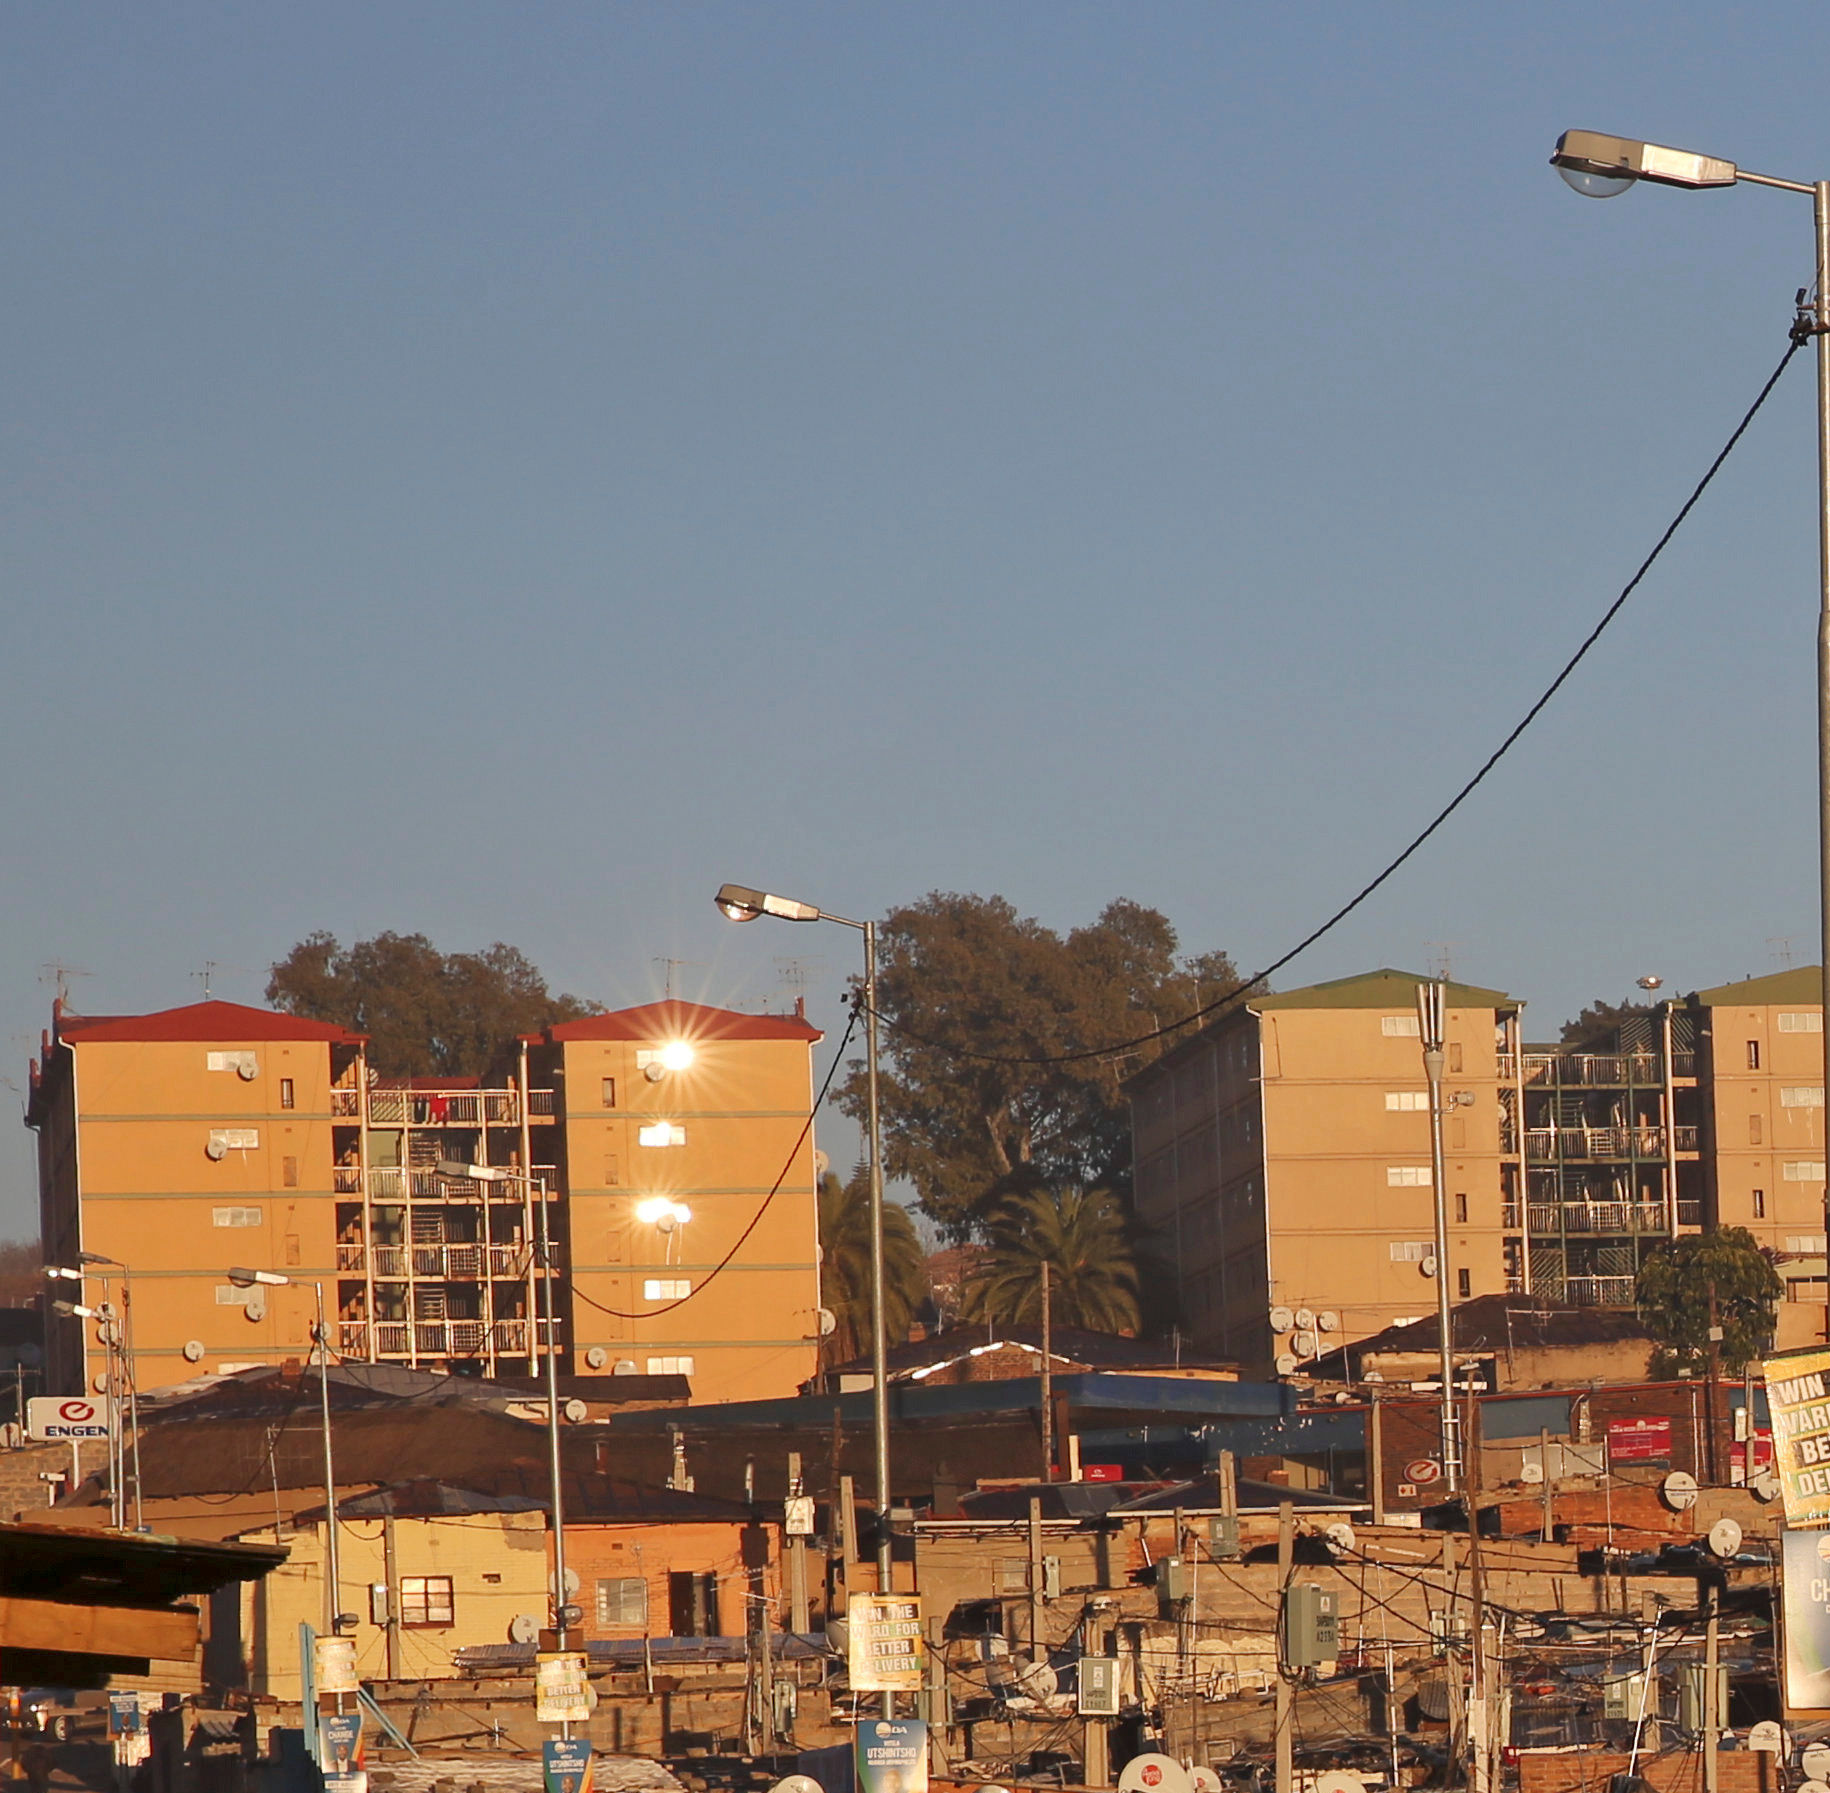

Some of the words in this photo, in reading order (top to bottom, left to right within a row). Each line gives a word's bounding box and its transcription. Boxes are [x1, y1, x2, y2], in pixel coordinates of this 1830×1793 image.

[1777, 1373, 1826, 1404] WIN
[45, 1426, 110, 1437] ENGEN
[895, 1621, 920, 1636] FOR
[892, 1726, 908, 1735] DA
